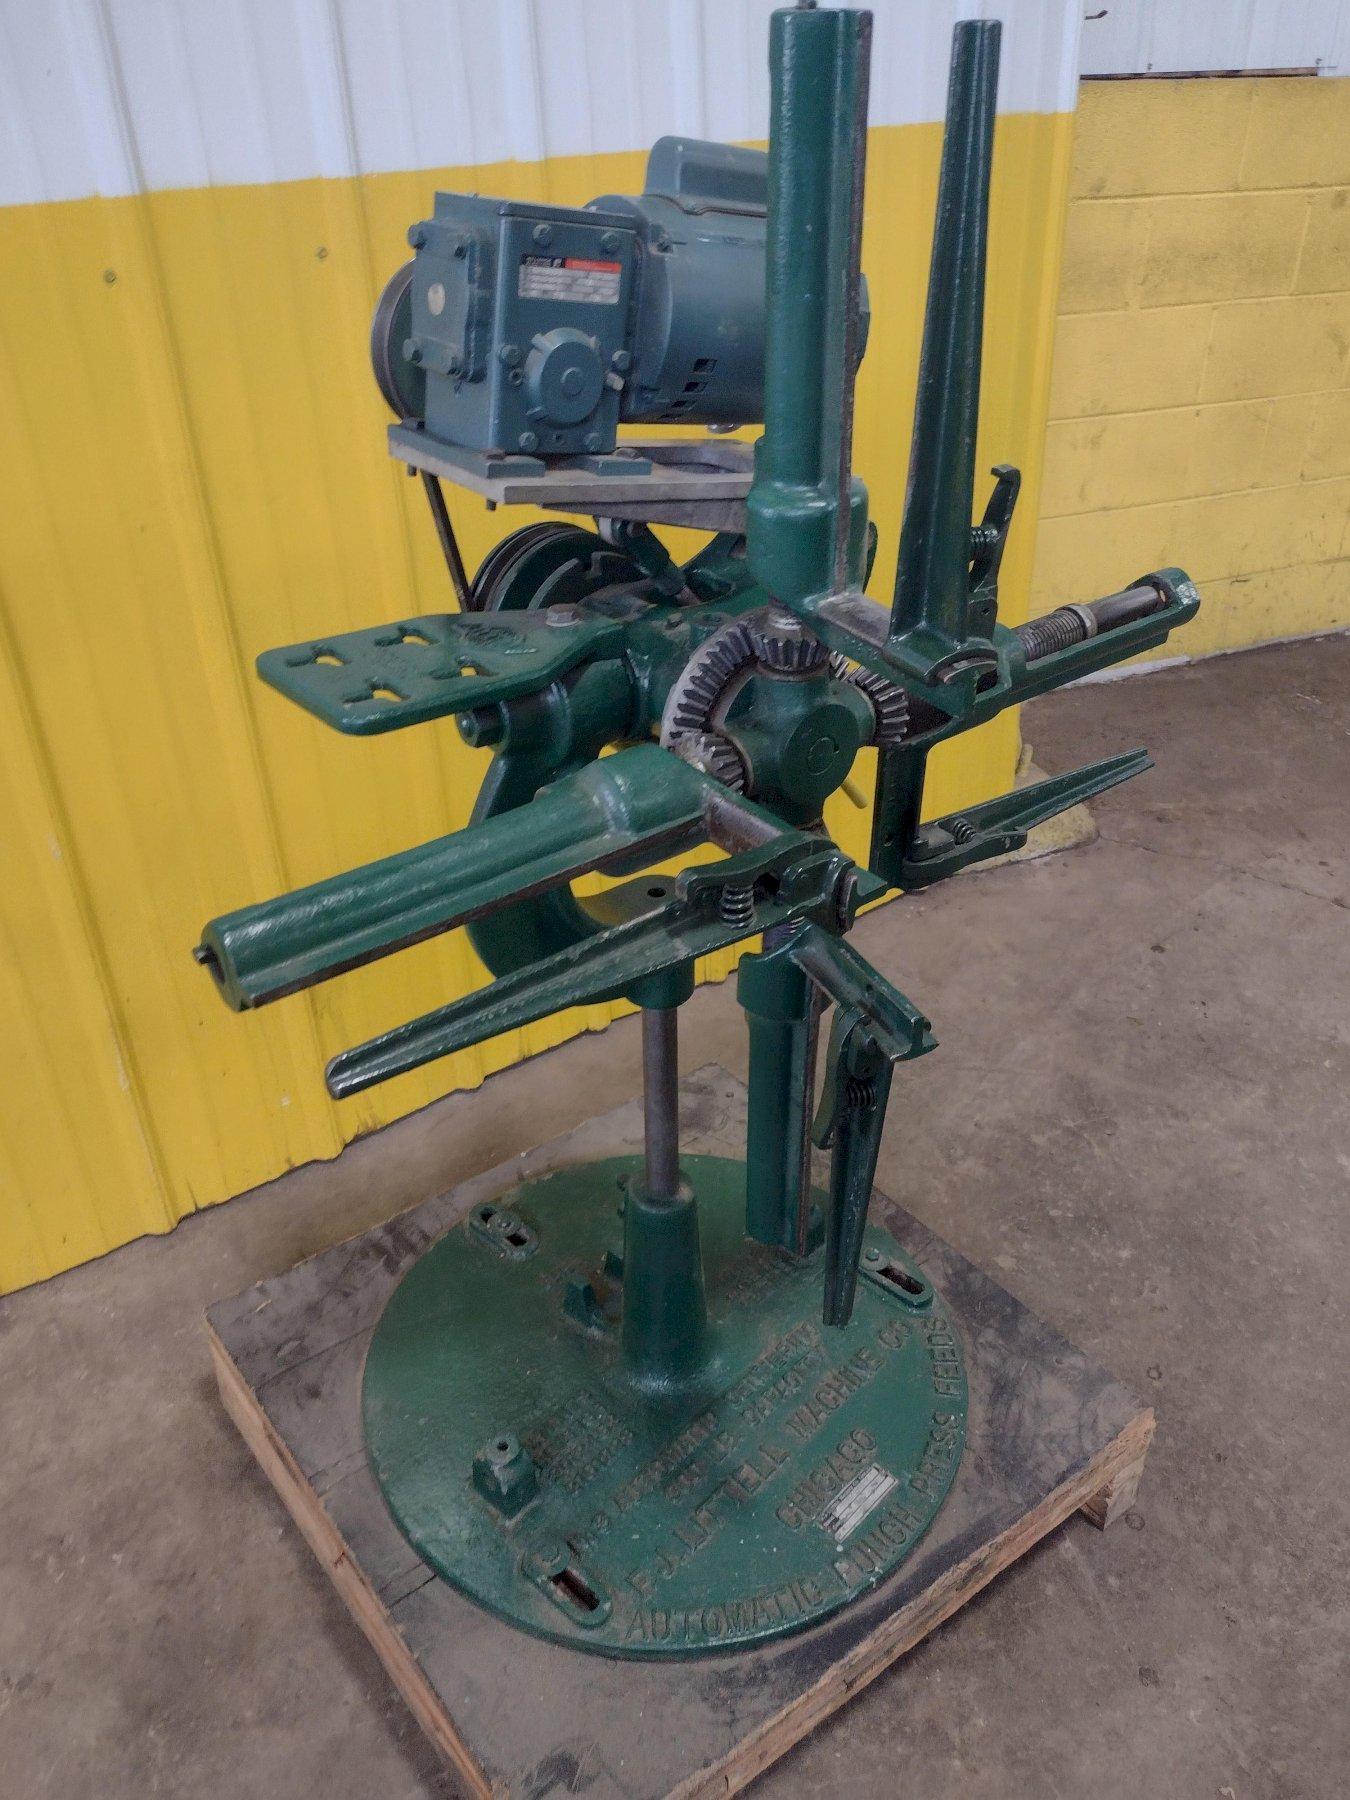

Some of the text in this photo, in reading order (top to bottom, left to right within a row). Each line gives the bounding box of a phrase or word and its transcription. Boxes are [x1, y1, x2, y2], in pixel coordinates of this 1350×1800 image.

[926, 1316, 962, 1397] FEEDS
[672, 1445, 790, 1553] LITTELL
[783, 1346, 885, 1443] MACHINE
[776, 1428, 877, 1528] CHICAGO
[910, 1410, 960, 1501] PRESS
[834, 1502, 924, 1597] PUNCH
[625, 1577, 826, 1641] AUTOMATIC
